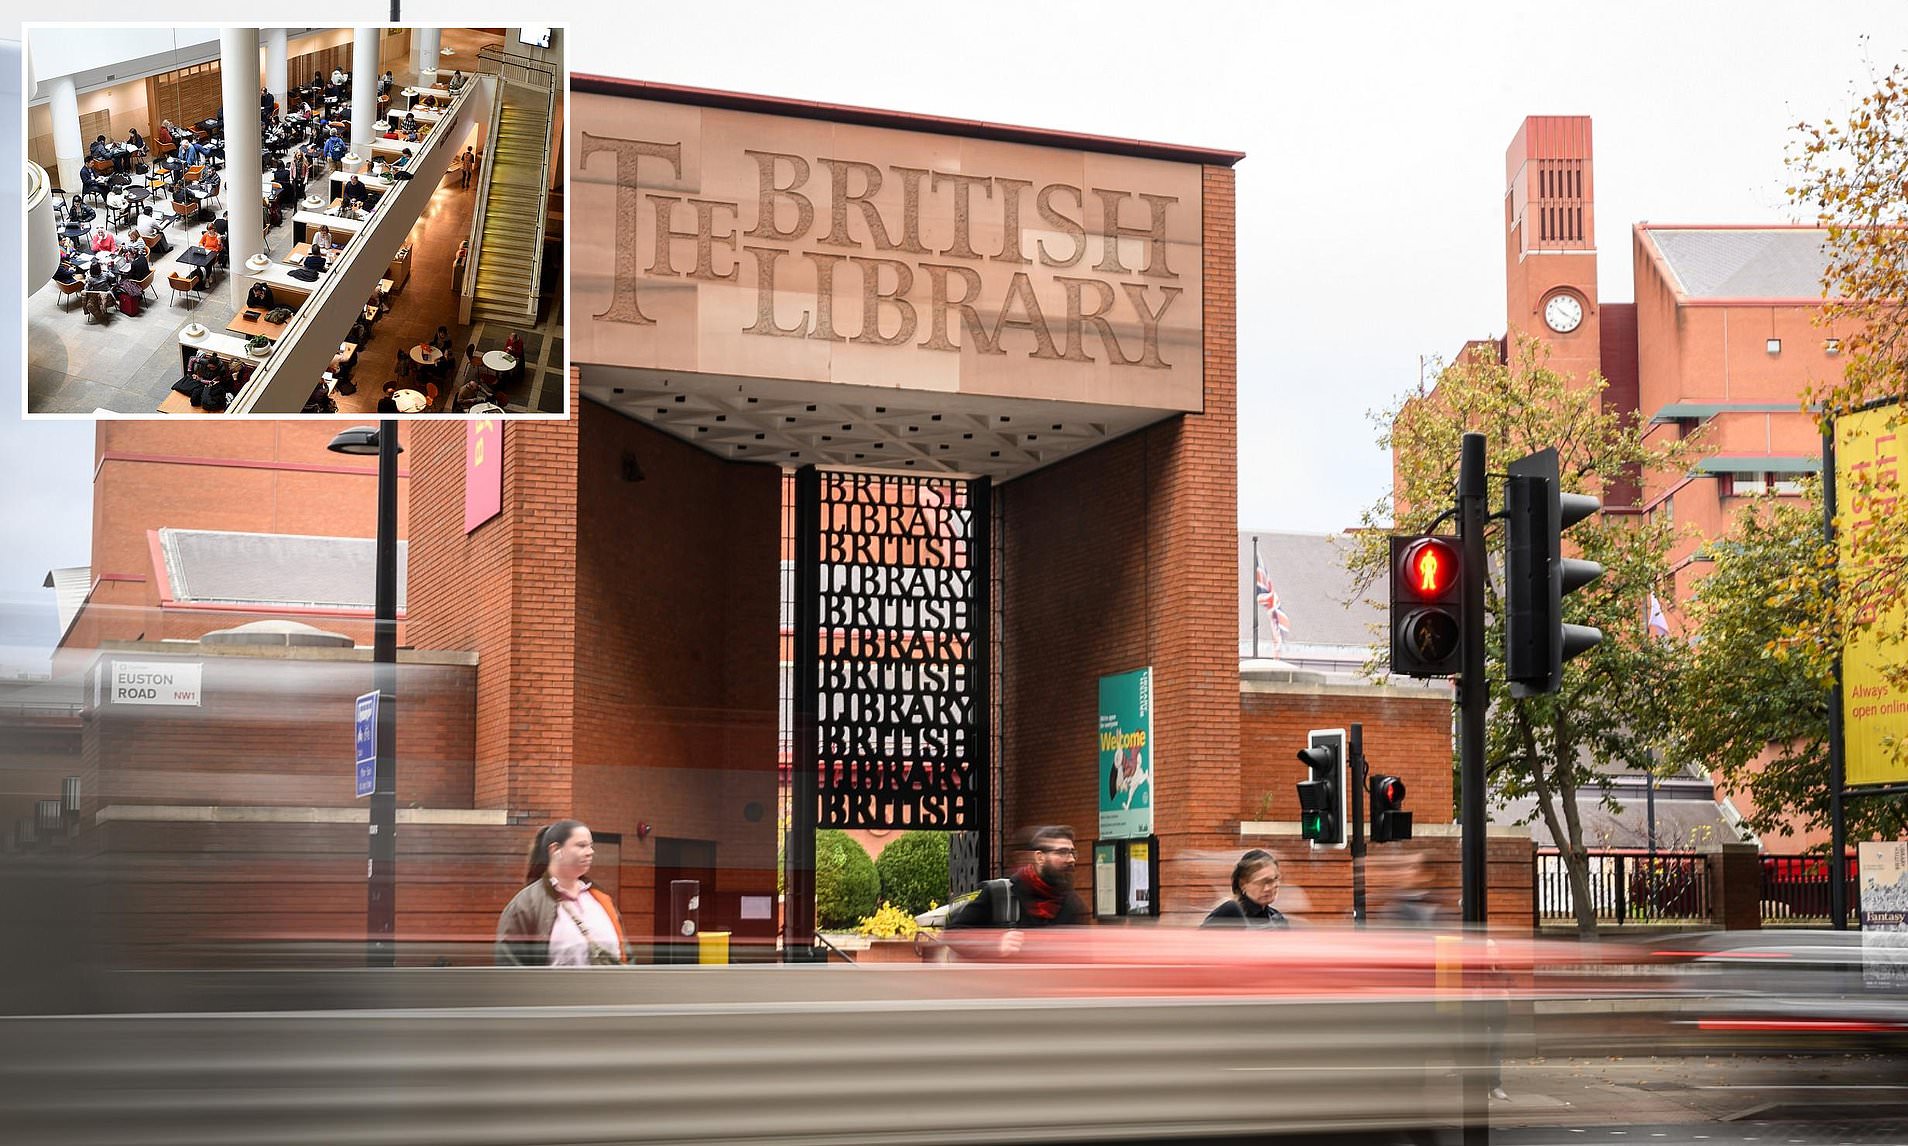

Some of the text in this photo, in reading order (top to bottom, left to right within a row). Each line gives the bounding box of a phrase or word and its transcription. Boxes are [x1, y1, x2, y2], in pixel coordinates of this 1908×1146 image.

[579, 131, 1180, 325] THE BRITISH
[741, 245, 1184, 370] LIBRARY
[822, 471, 972, 508] BRITISH
[822, 502, 973, 538] LIBRARY
[822, 533, 972, 569] BRITISH
[822, 564, 973, 599] LIBRARY
[821, 595, 972, 630] BRITISH
[821, 627, 972, 661] LIBRARY
[118, 673, 173, 685] EUSTON
[821, 659, 971, 692] BRITISH
[118, 688, 195, 700] ROAD NW1
[821, 692, 972, 725] LIBRARY
[1852, 684, 1888, 701] Always
[1853, 704, 1877, 721] open
[820, 725, 971, 758] BRITISH
[1101, 728, 1146, 752] Welcome
[820, 759, 972, 791] LIBRARY
[819, 793, 971, 826] BRITISH
[1866, 911, 1905, 924] Fantasy
